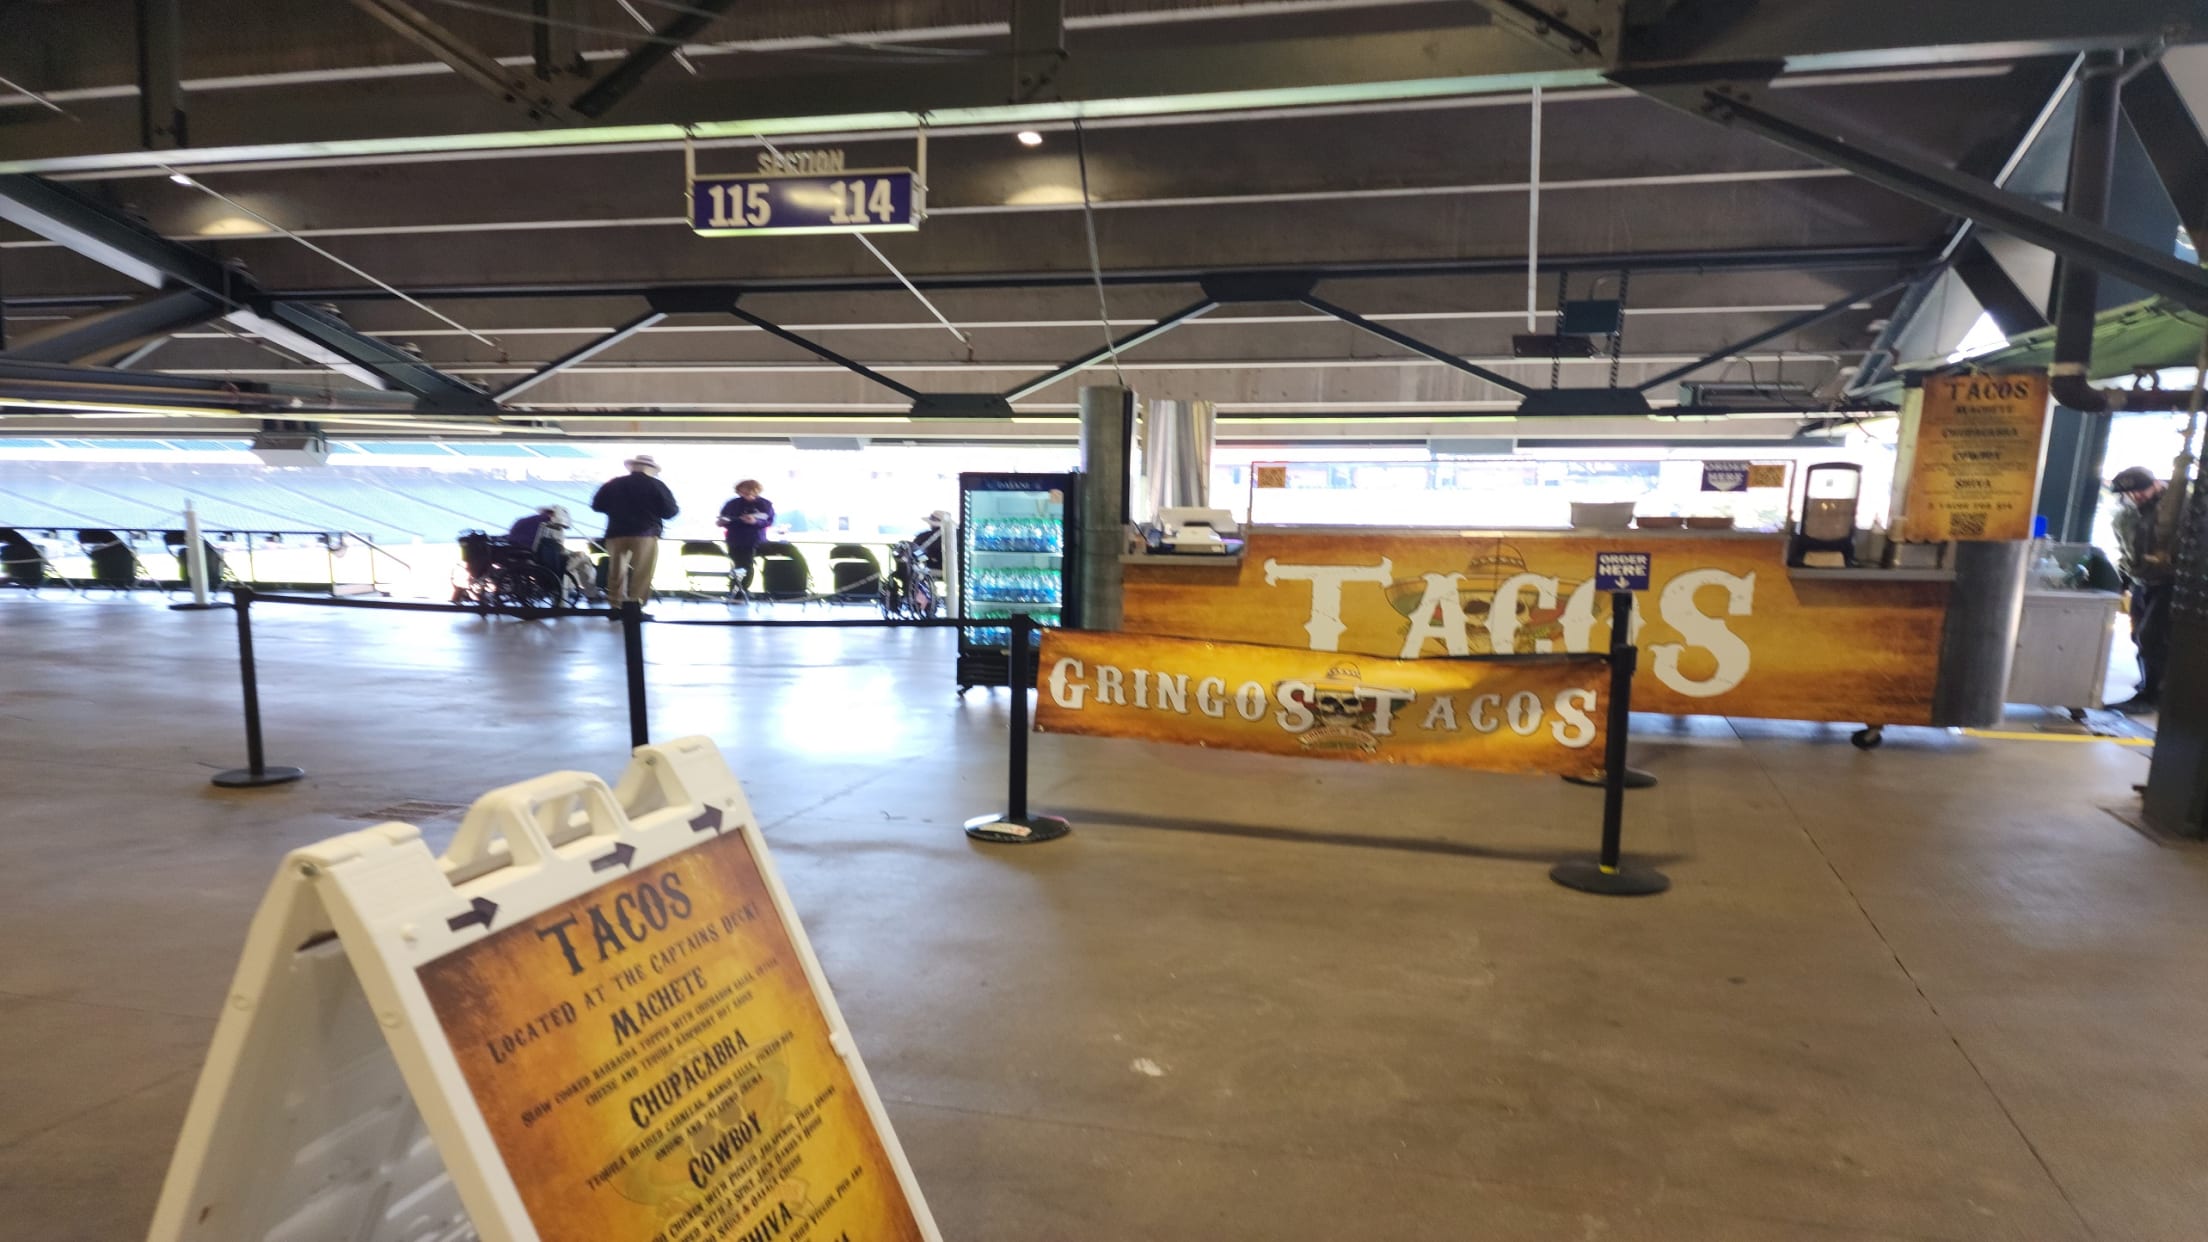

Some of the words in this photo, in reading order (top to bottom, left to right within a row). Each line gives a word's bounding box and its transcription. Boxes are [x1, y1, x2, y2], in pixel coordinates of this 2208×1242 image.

[757, 150, 845, 174] SECTION
[708, 183, 772, 227] 115
[829, 179, 895, 223] 114
[1944, 381, 2029, 400] TACOS
[1600, 554, 1648, 564] ORDER
[1600, 564, 1647, 576] HERE
[1048, 657, 1316, 733] GRINGOS
[1353, 684, 1598, 749] TACOS
[536, 871, 693, 977] TACOS
[487, 1001, 577, 1064] LOCATED
[583, 984, 605, 1011] AT
[611, 964, 646, 991] THE
[610, 966, 707, 1047] MACHETE
[671, 1009, 694, 1031] WITH
[620, 1065, 640, 1084] AND
[629, 1028, 749, 1129] CHUPACABRA
[688, 1110, 762, 1189] COWBOY
[585, 1155, 628, 1192] TEQUILA
[669, 1203, 704, 1238] CHICKEN
[704, 1181, 728, 1206] WITH
[702, 1205, 726, 1230] WITH
